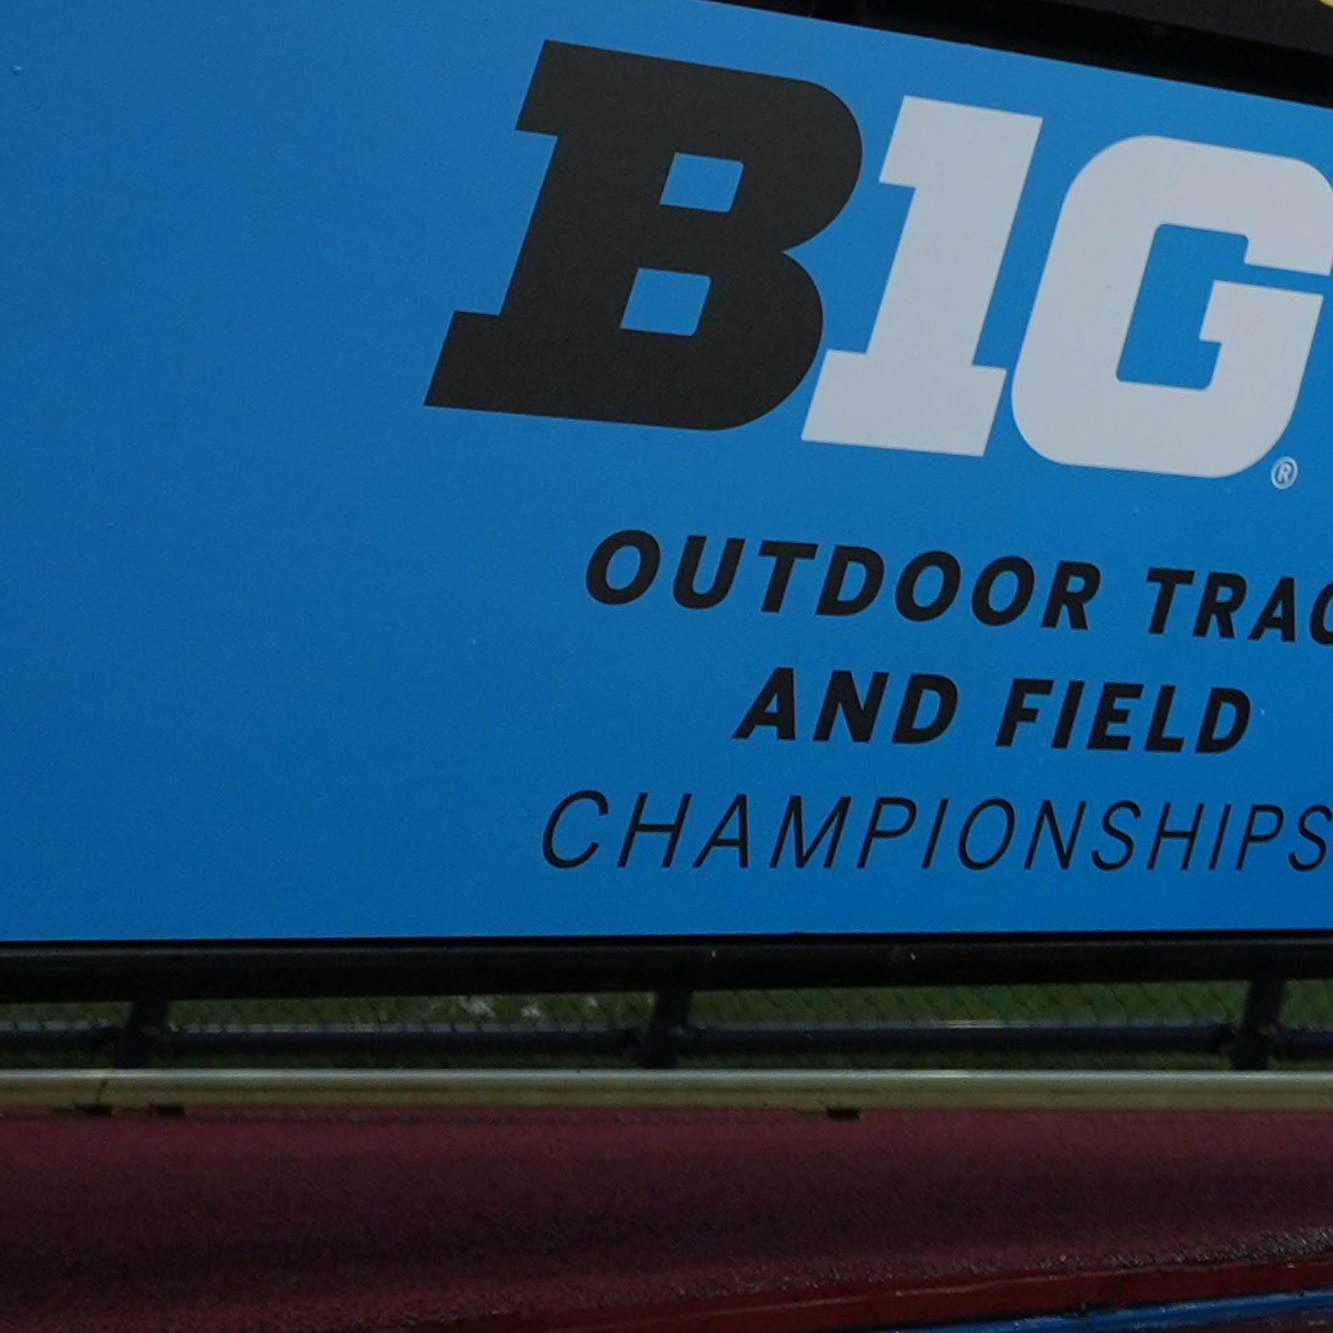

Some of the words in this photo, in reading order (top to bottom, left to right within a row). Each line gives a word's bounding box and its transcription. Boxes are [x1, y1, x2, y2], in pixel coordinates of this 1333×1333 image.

[584, 528, 1102, 631] OUTDOOR
[732, 666, 959, 746] AND
[994, 677, 1253, 755] FIELD
